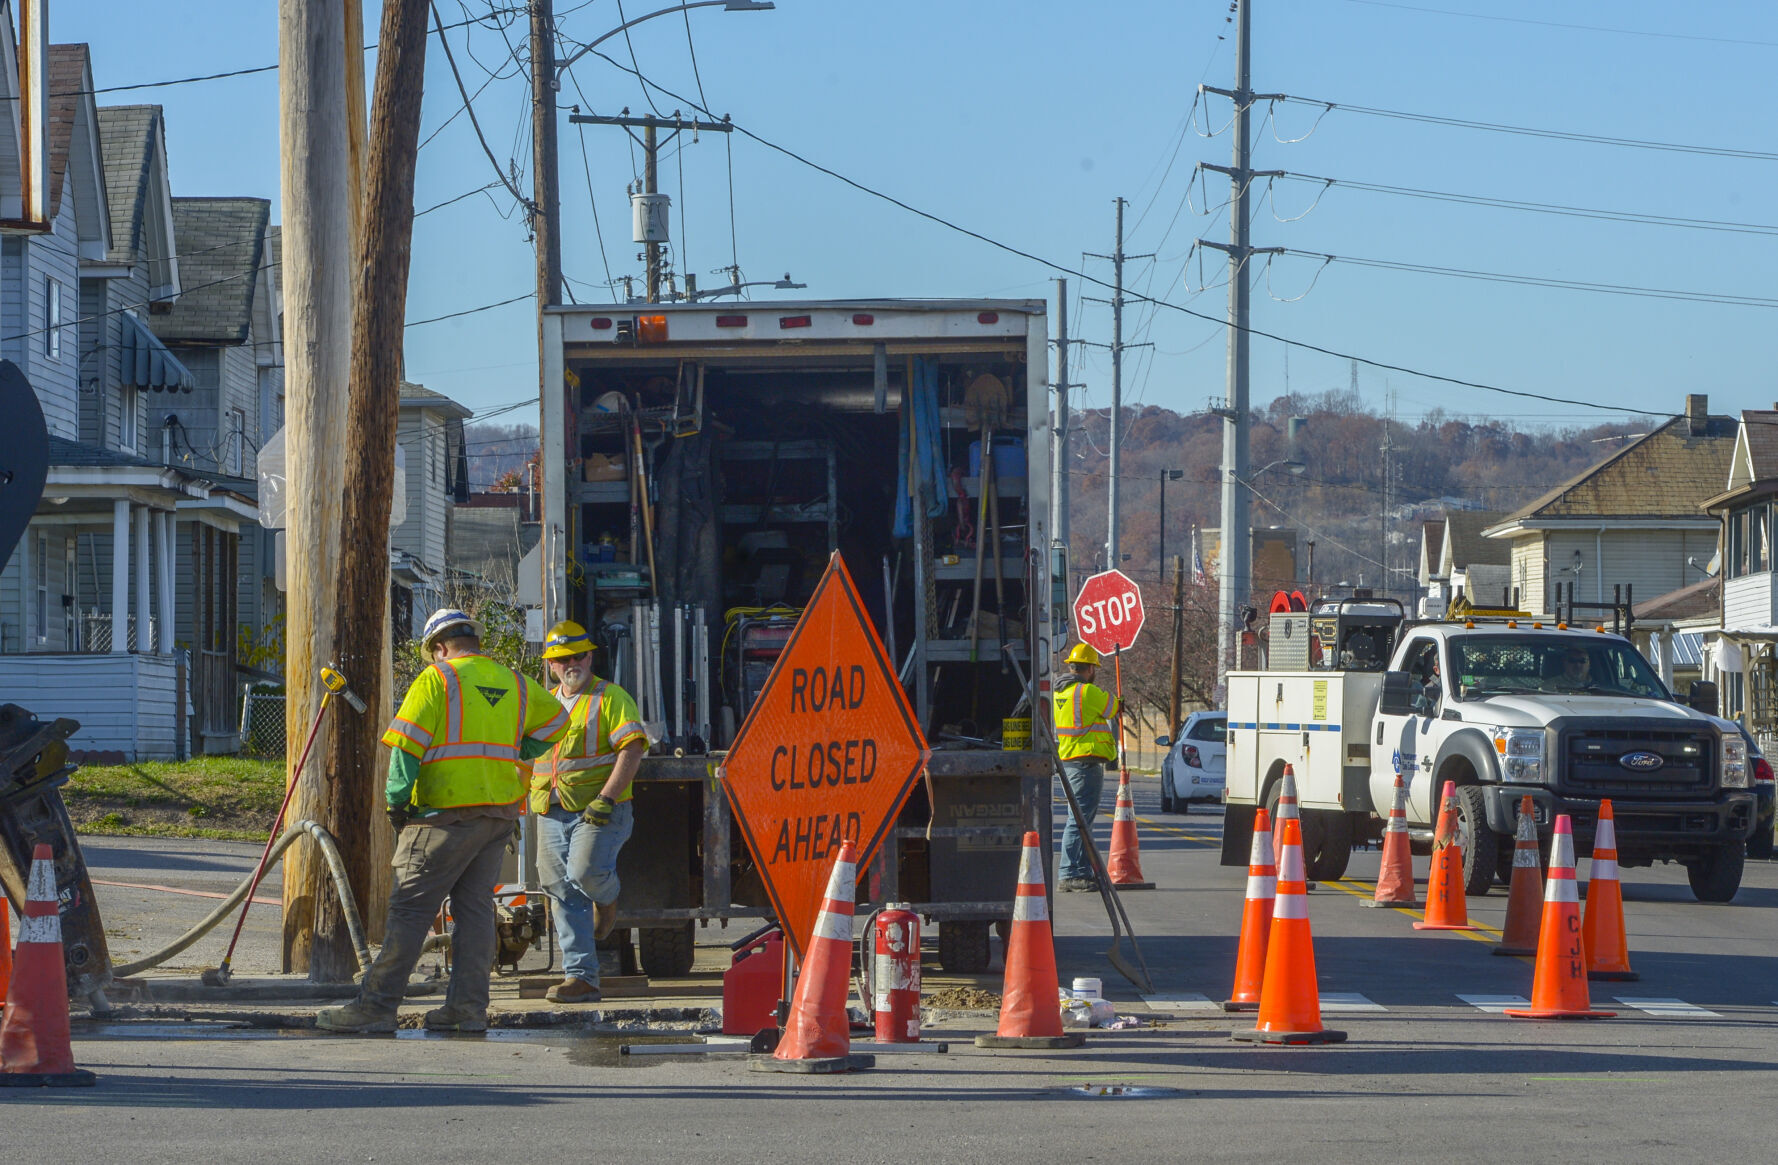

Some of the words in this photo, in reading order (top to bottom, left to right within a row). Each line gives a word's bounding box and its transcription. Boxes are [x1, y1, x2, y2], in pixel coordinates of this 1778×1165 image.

[1080, 592, 1137, 634] STOP
[791, 665, 866, 713] ROAD
[1011, 720, 1022, 732] LINE
[1011, 736, 1022, 748] LINE
[770, 738, 877, 791] CLOSED
[1630, 755, 1655, 766] Ford
[768, 811, 862, 865] AHEAD
[1439, 856, 1449, 903] CJH
[1567, 914, 1582, 979] CJH
